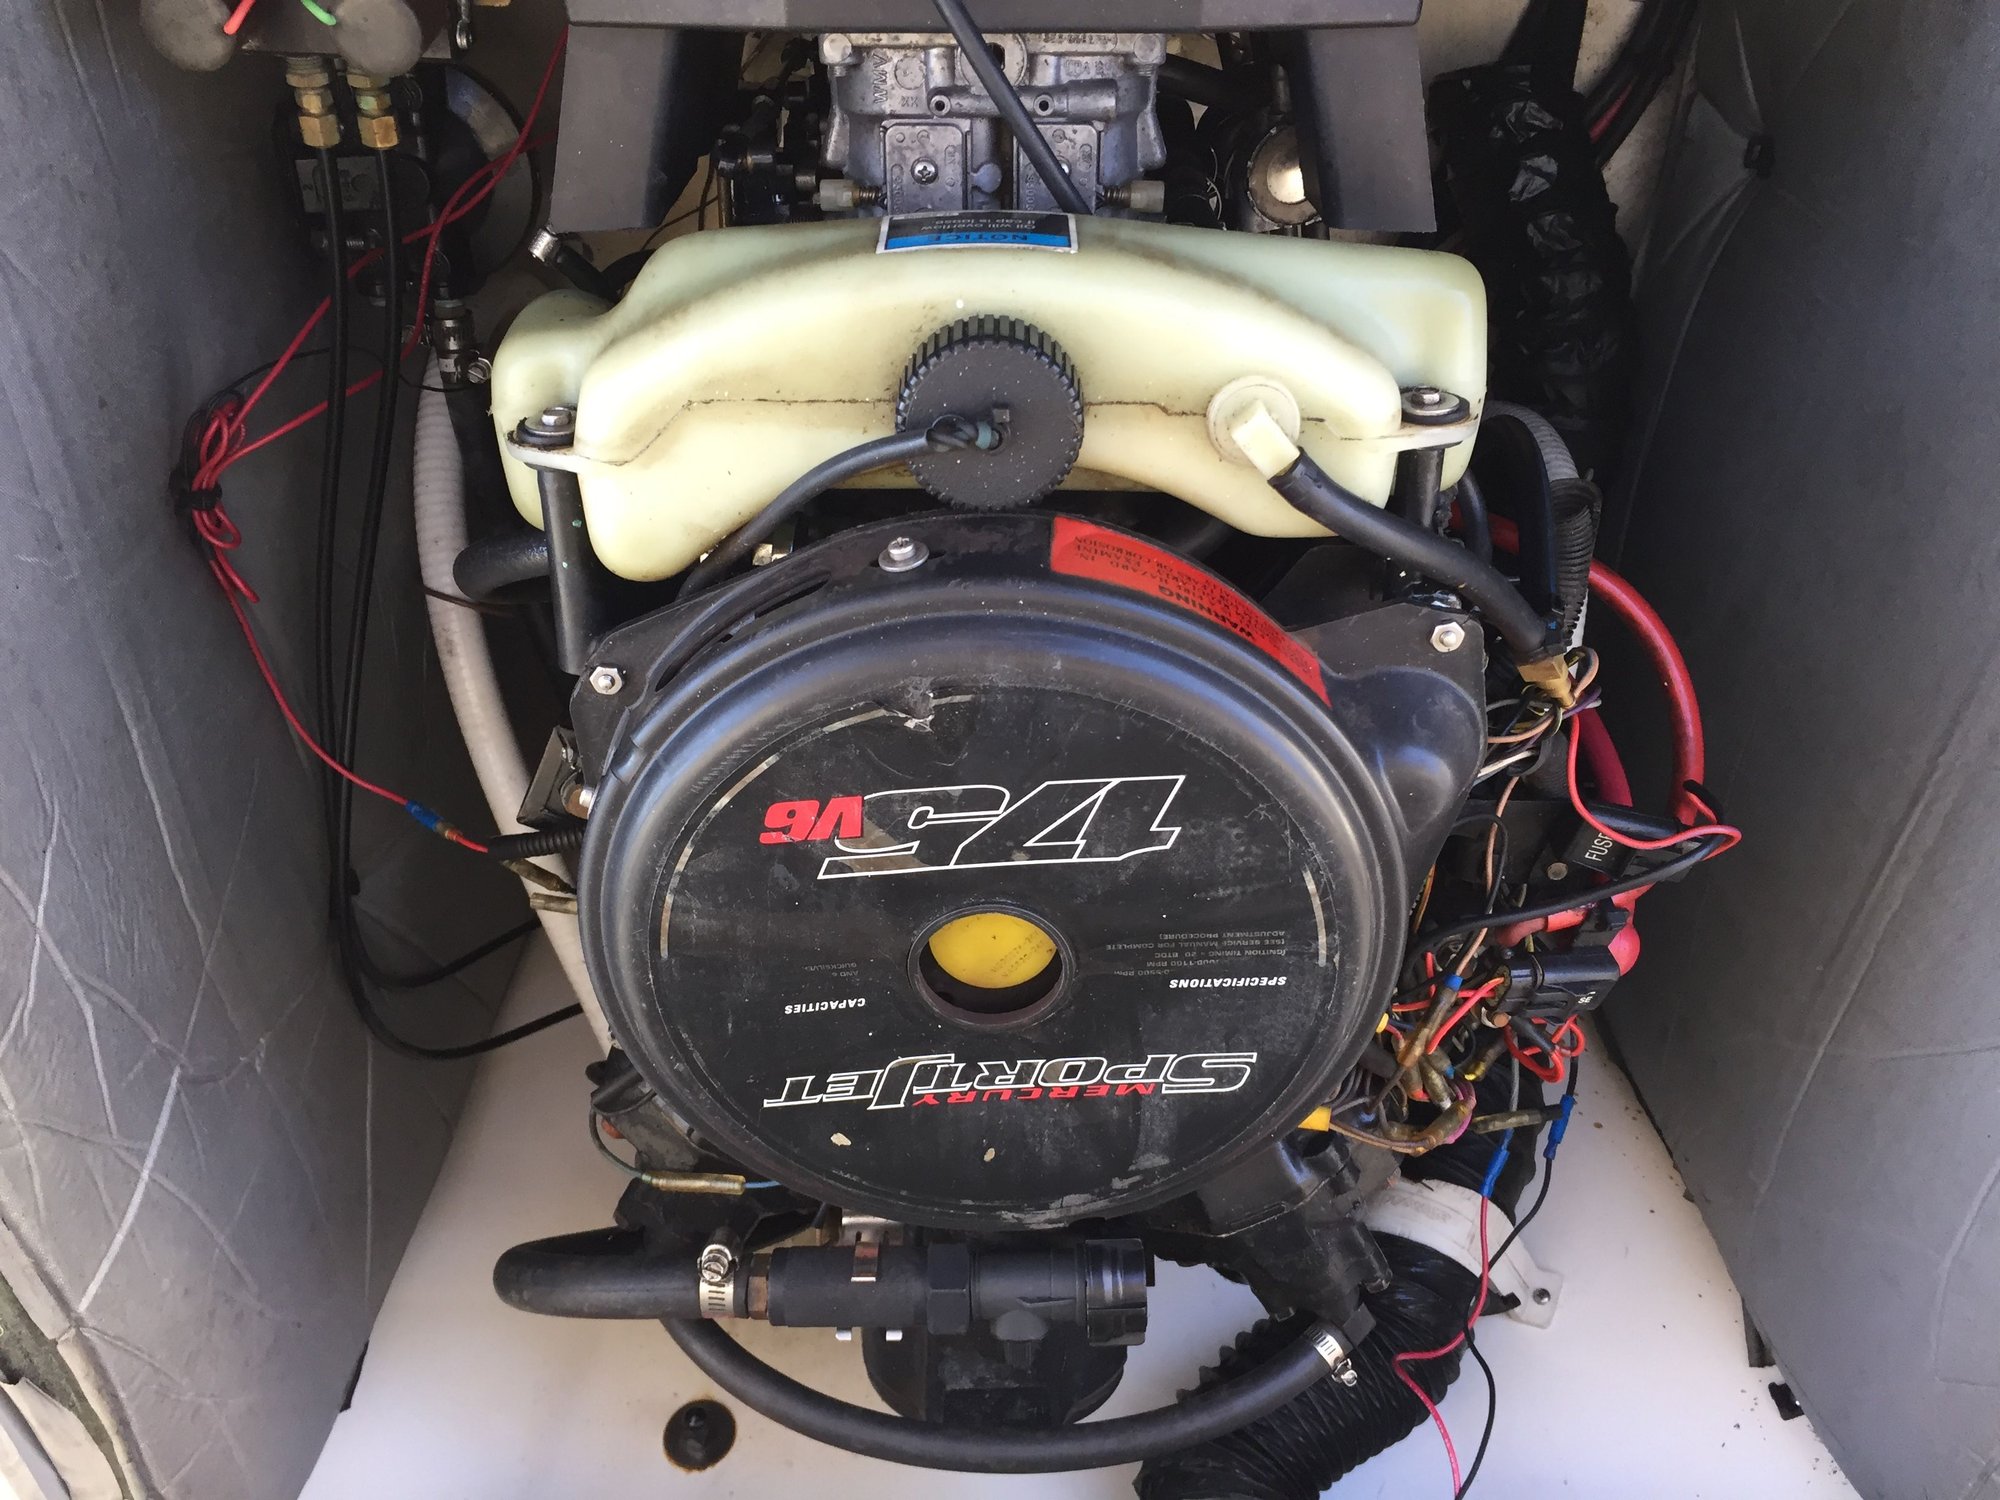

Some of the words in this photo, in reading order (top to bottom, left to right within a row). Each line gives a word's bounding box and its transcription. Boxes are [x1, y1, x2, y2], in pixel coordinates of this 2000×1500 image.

[873, 52, 888, 103] WMV
[928, 234, 1028, 242] NOTICE
[1158, 585, 1254, 640] WARNING
[759, 794, 864, 844] V6
[817, 774, 1186, 880] 175
[1105, 942, 1154, 950] COMPLETE
[1178, 940, 1218, 948] MANUAL
[1146, 960, 1168, 968] RPM
[1169, 976, 1287, 988] SPECIFICATIONS
[784, 998, 866, 1014] CAPACITIES
[909, 1082, 1156, 1106] MERCURY
